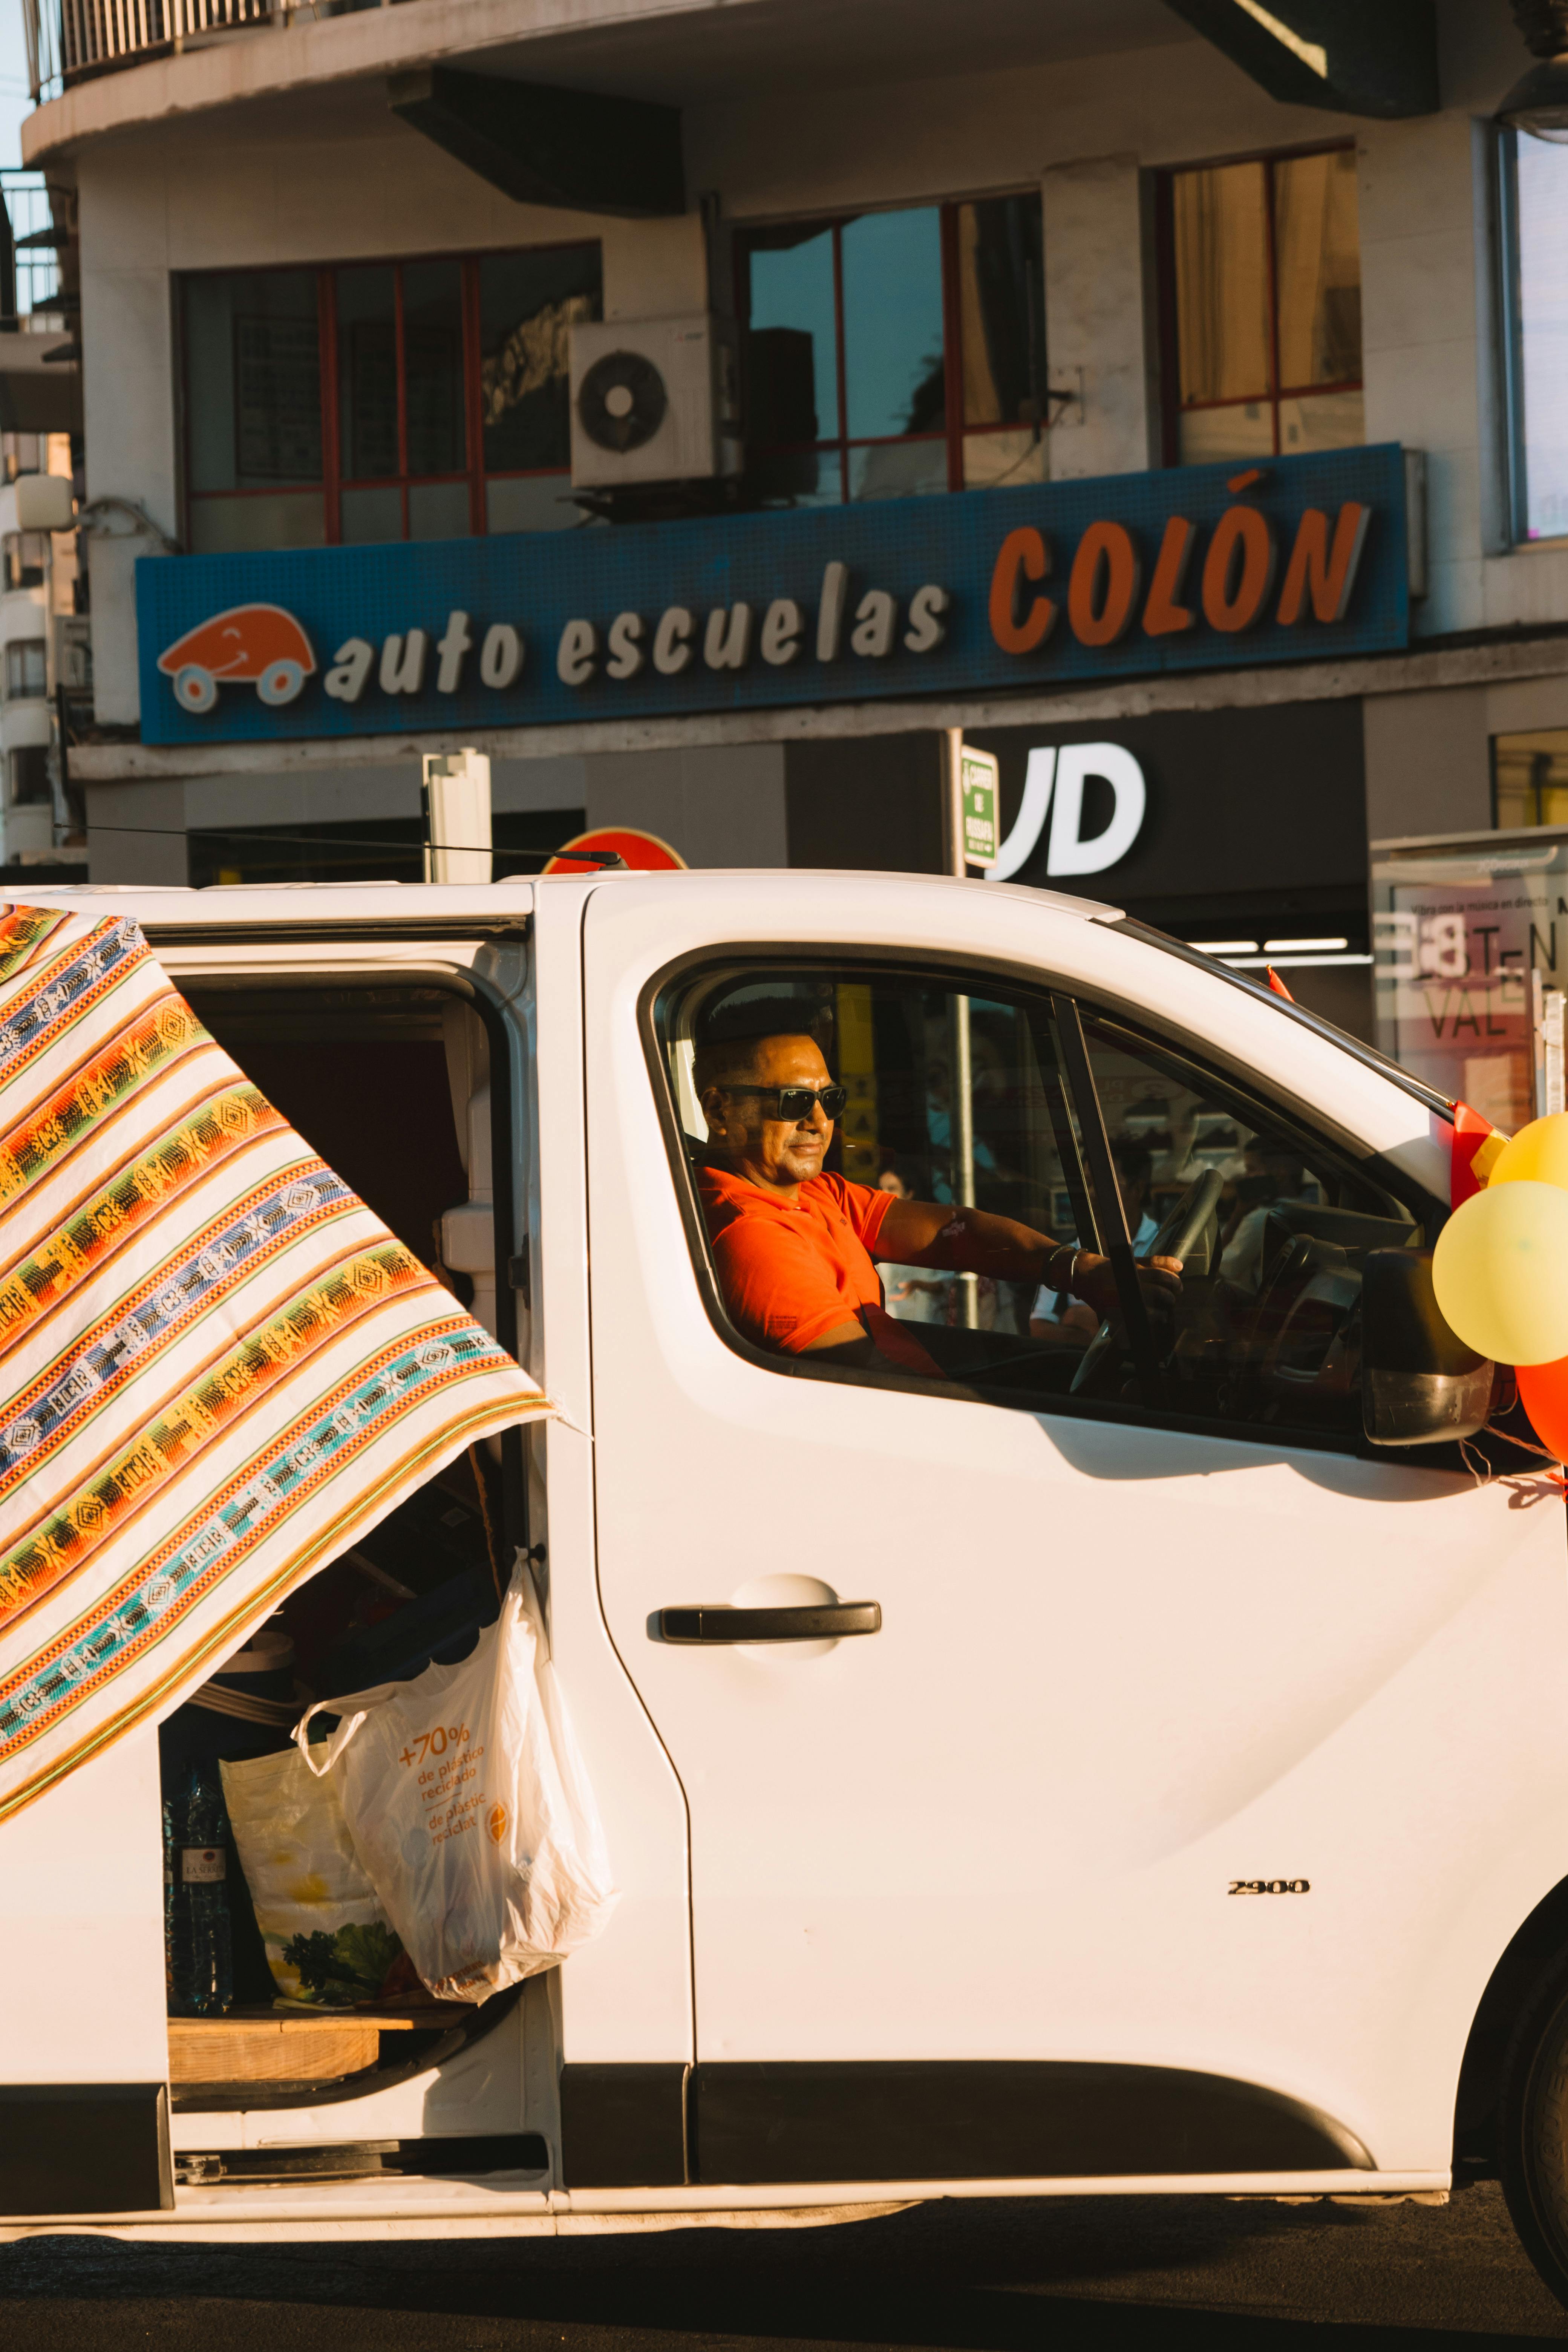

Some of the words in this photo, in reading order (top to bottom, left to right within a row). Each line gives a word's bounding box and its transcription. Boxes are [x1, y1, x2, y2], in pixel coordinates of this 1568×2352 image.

[324, 611, 521, 703] auto
[557, 561, 949, 685] escuelas
[988, 469, 1370, 654] COLÓN
[984, 742, 1146, 881] JD
[1411, 904, 1435, 916] Vibra
[1437, 905, 1454, 914] con
[1456, 901, 1465, 913] la
[1501, 900, 1512, 909] en
[399, 1723, 470, 1767] +70%
[418, 1772, 434, 1785] de
[438, 1746, 484, 1780] plástico
[421, 1767, 476, 1801] reciclado
[429, 1815, 443, 1830] de
[432, 1815, 477, 1846] reciclat
[1227, 1879, 1311, 1895] 2900
